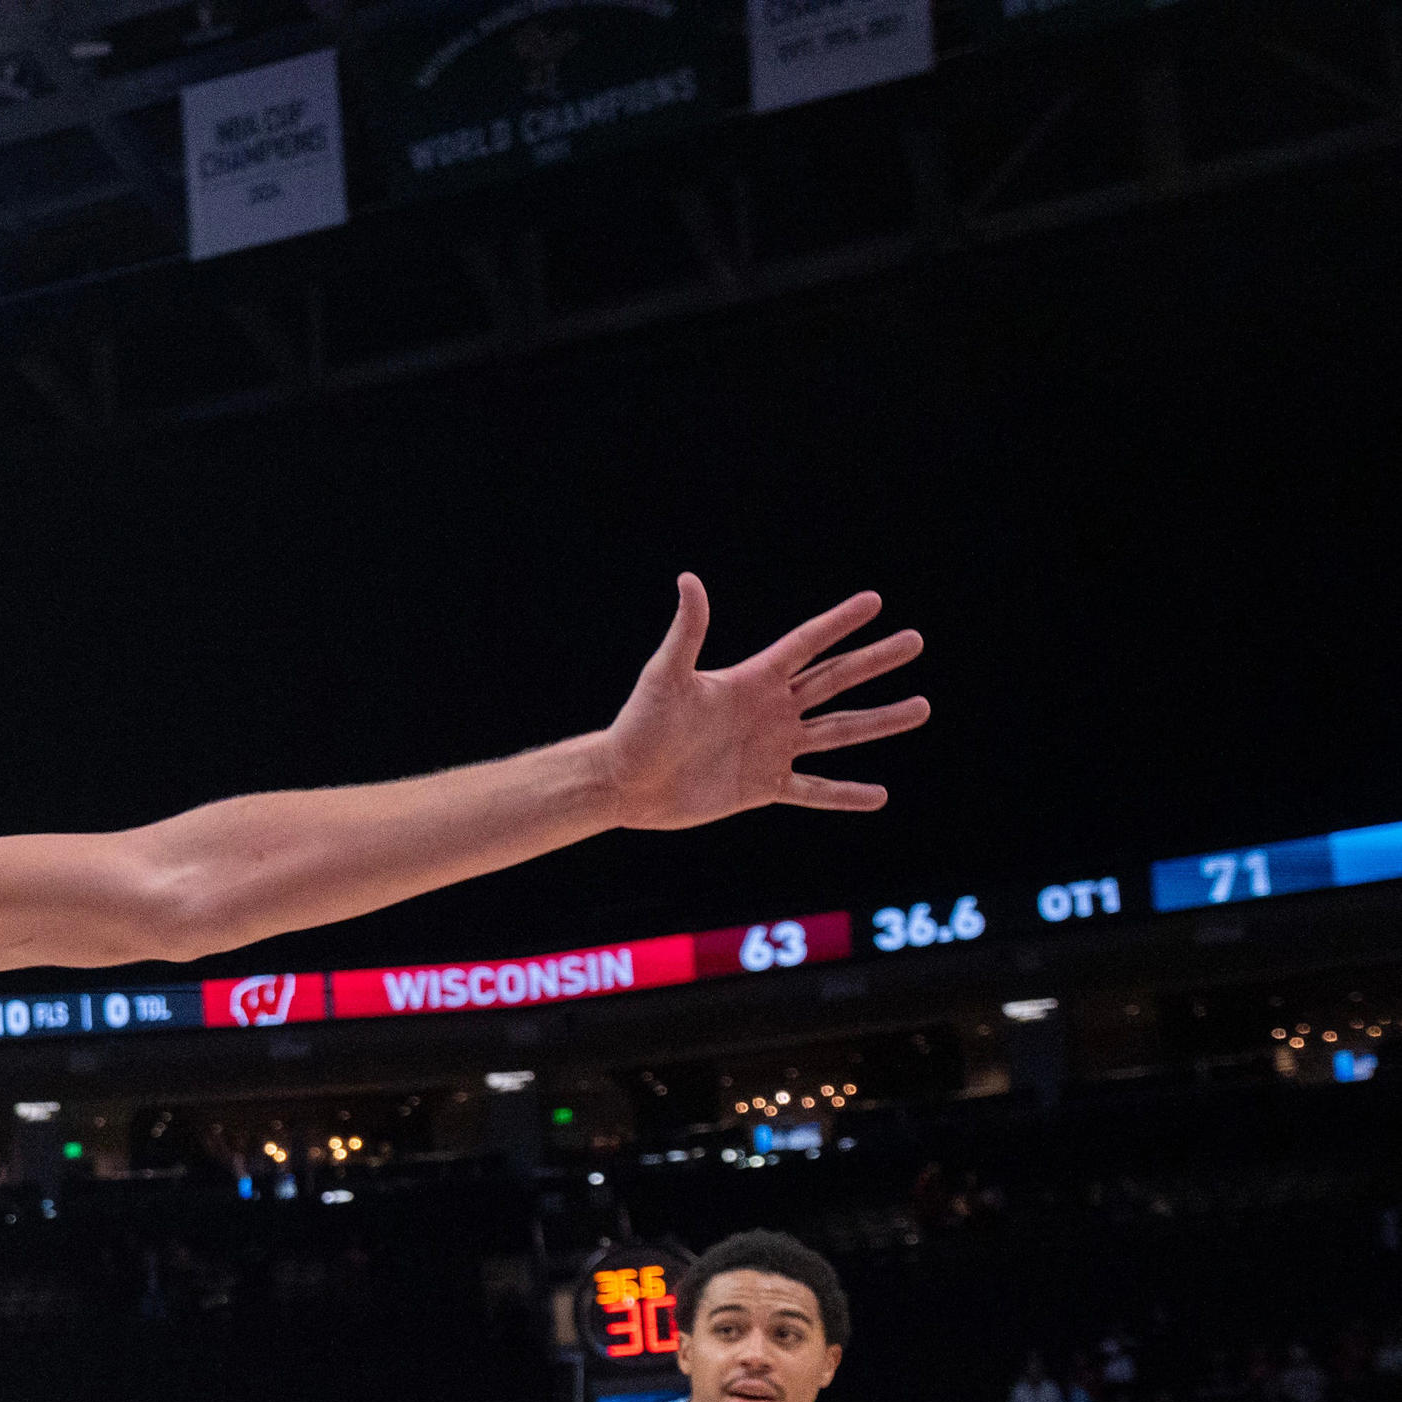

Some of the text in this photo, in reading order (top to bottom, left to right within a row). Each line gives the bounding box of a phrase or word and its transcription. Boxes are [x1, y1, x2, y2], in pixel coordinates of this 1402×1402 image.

[382, 948, 634, 1011] WISCONSIN
[739, 920, 807, 971] 63
[872, 895, 986, 952] 36.6
[1037, 876, 1121, 922] OT1
[1200, 849, 1272, 903] 71
[103, 992, 130, 1028] 0
[603, 1294, 680, 1357] 30
